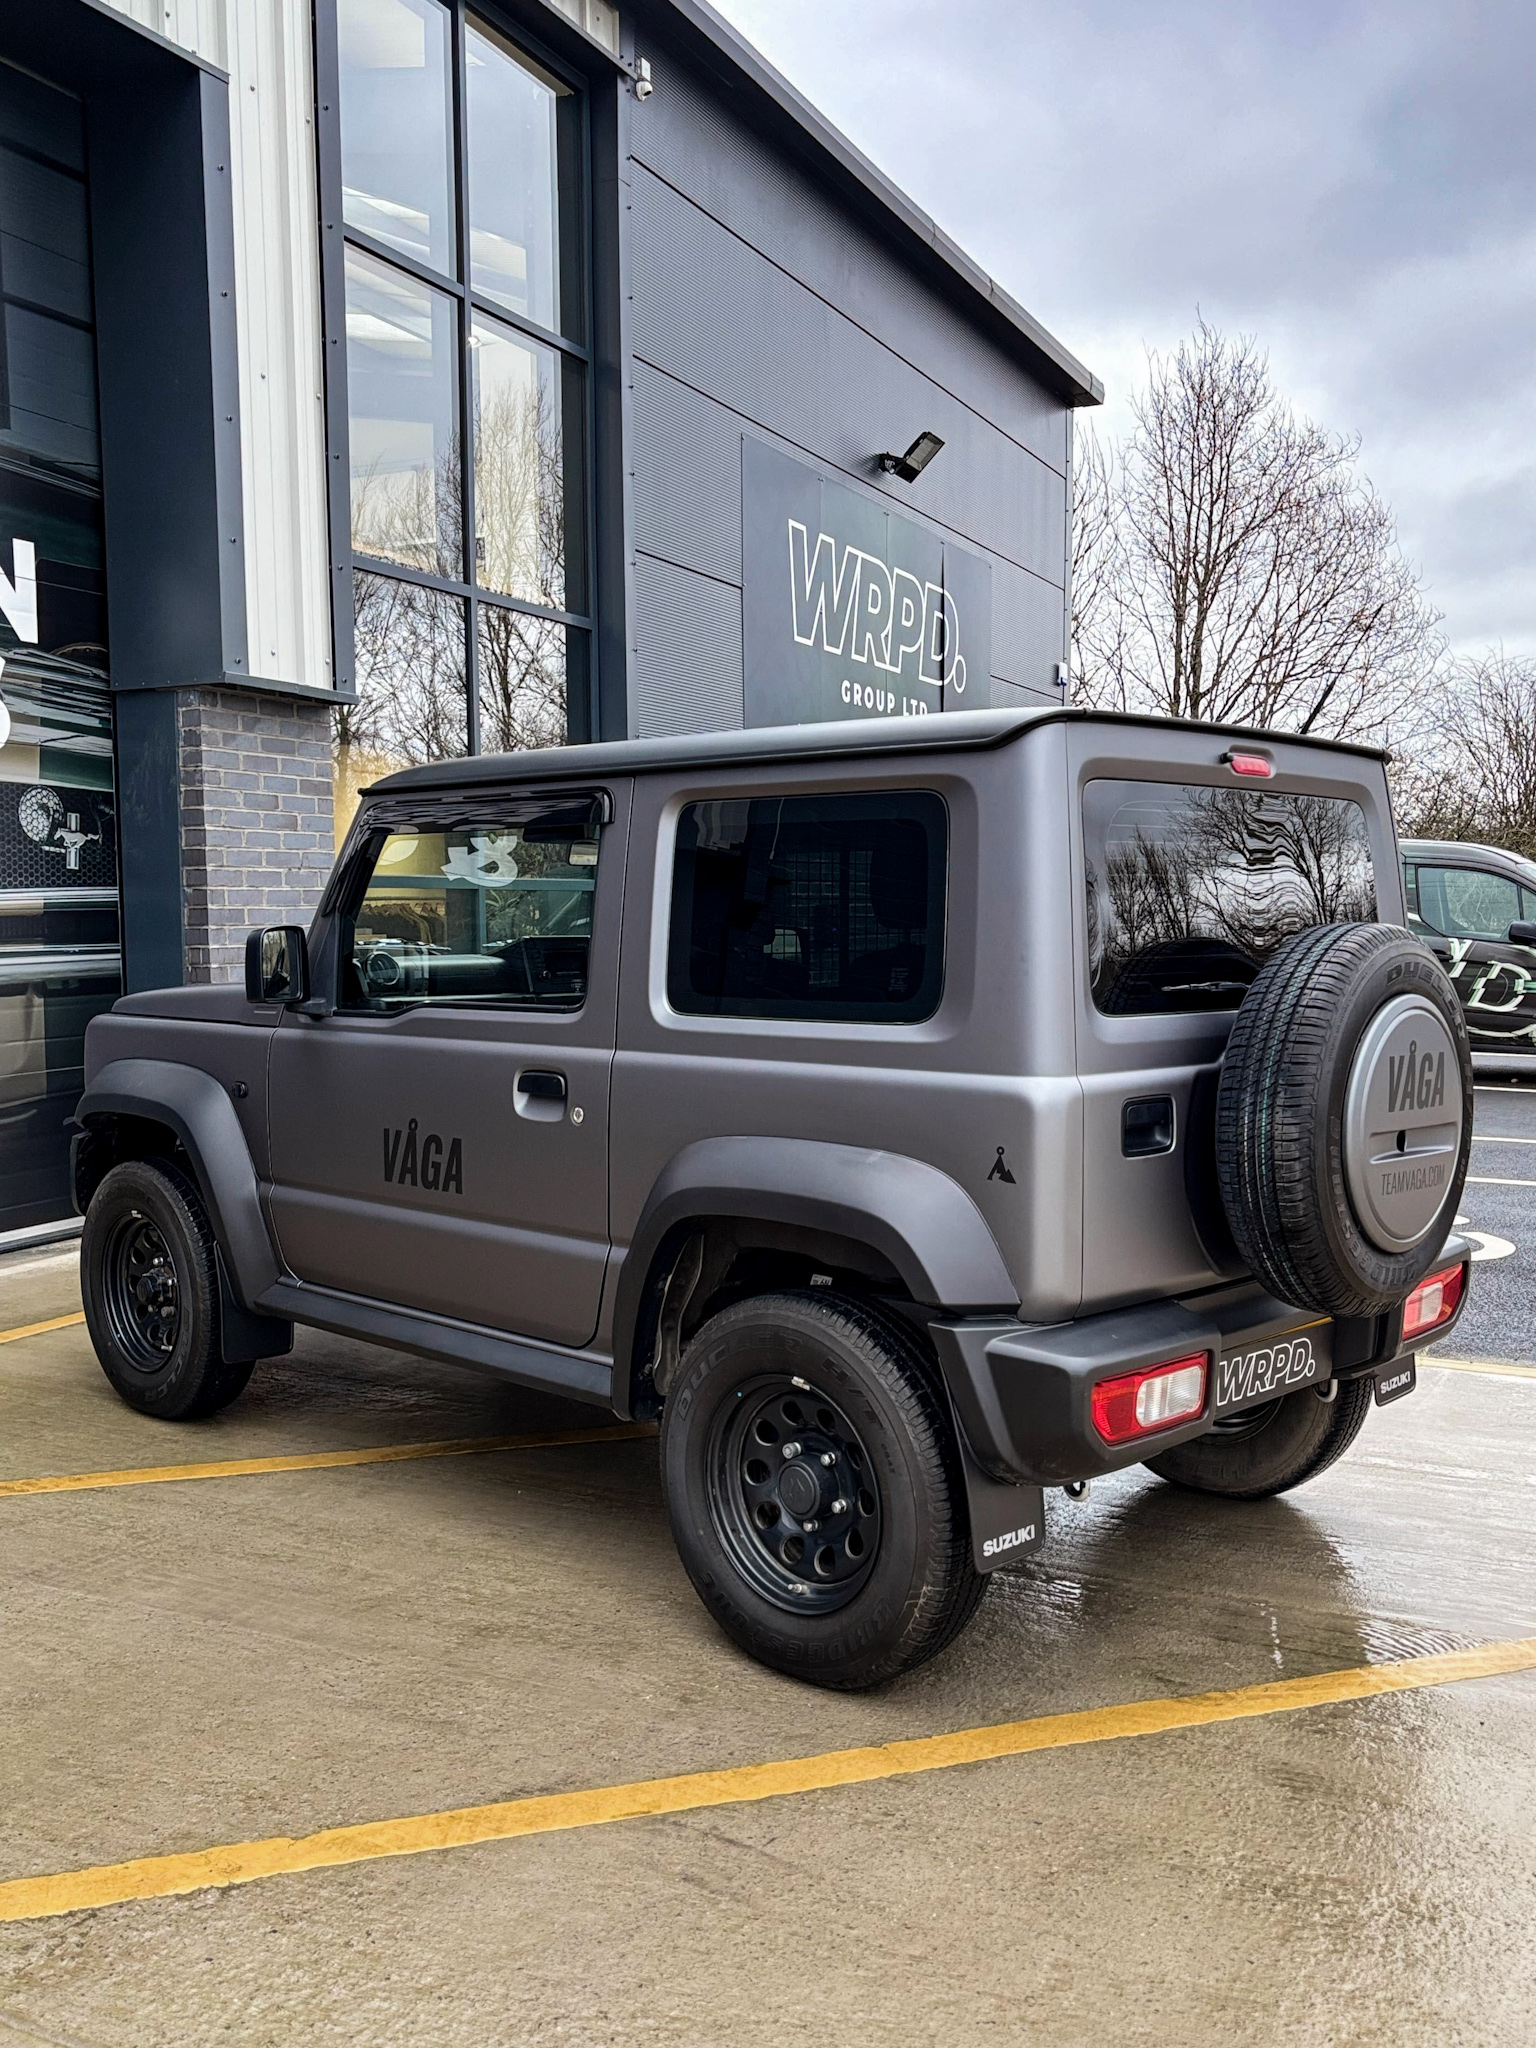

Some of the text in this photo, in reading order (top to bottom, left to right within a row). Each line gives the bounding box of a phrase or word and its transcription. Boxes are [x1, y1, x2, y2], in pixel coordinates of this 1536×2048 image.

[788, 518, 967, 694] WRPD.
[841, 680, 928, 717] GROUP LTD
[1388, 1040, 1446, 1113] VÅGA
[382, 1117, 464, 1195] VÅGA
[1381, 1164, 1446, 1196] TEAMVAGA.COM
[1216, 1337, 1317, 1406] WRPD.
[1379, 1371, 1412, 1394] SUZUKI
[982, 1524, 1036, 1557] SUZUKI
